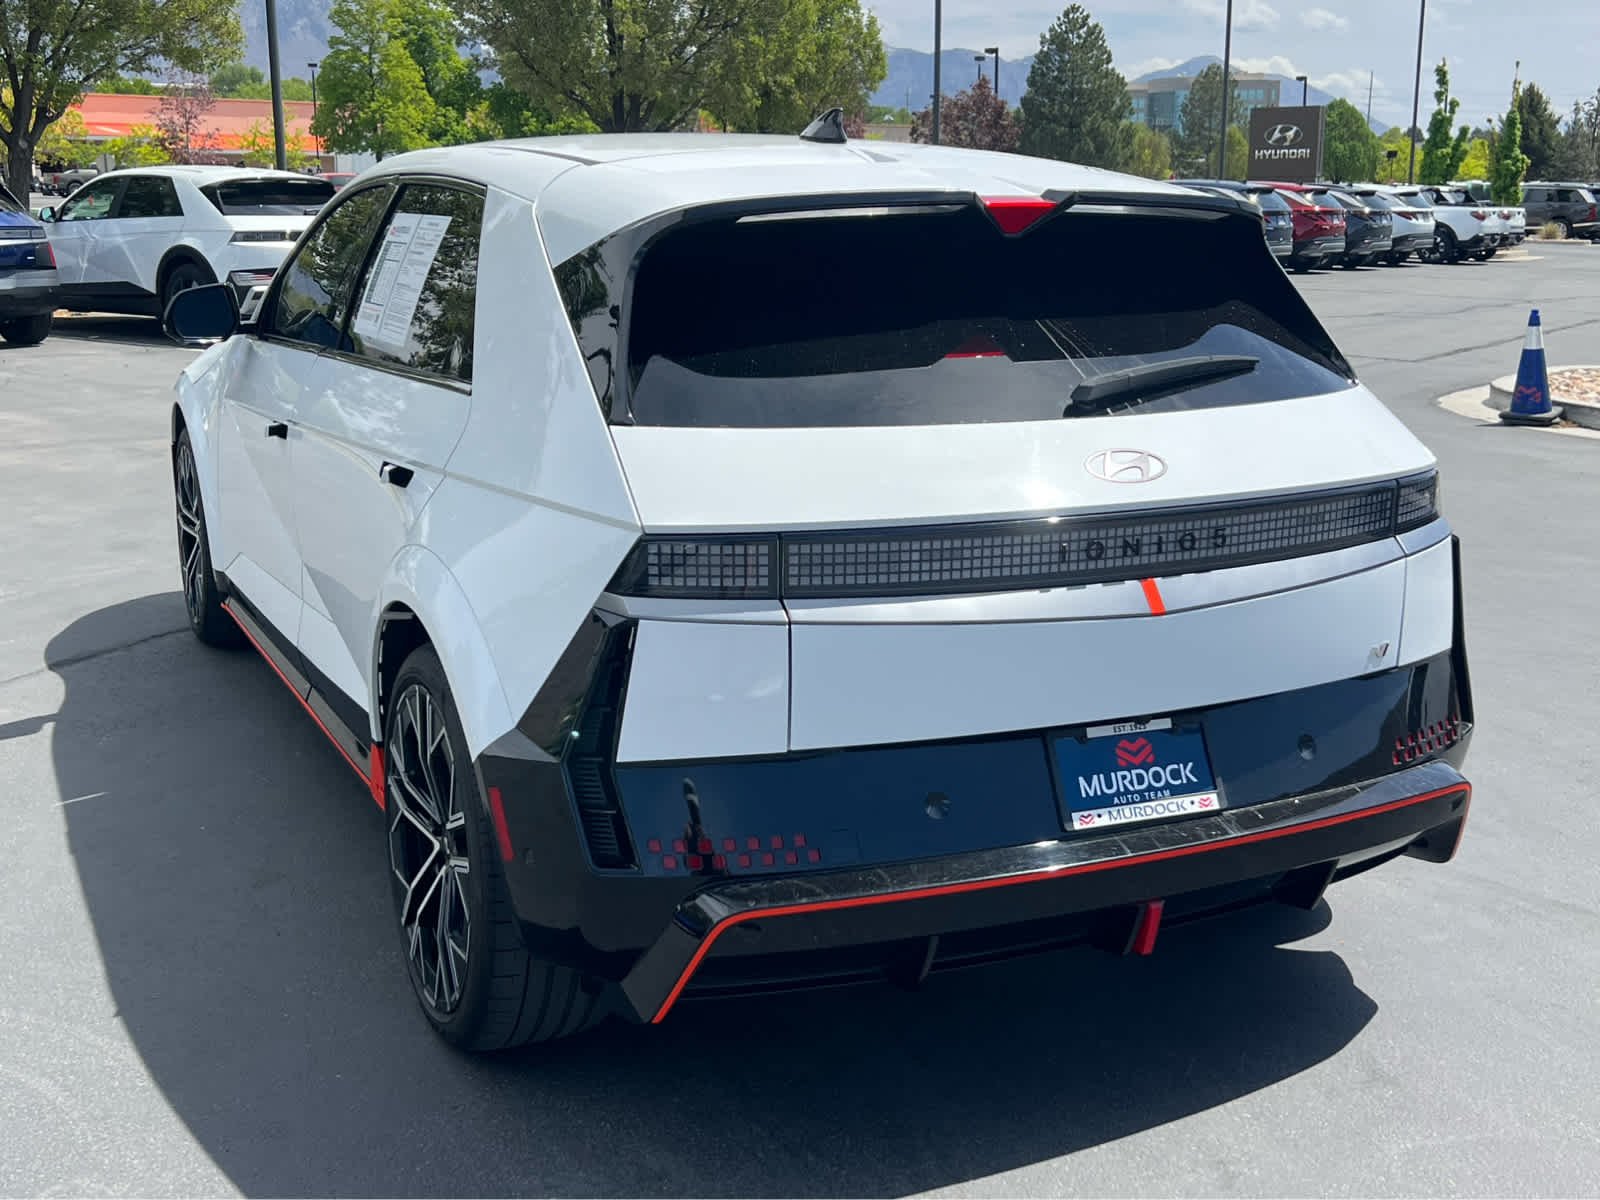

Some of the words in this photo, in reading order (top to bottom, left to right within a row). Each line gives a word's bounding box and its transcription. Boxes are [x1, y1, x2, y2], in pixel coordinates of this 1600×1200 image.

[1254, 148, 1311, 160] HYUNDAI
[1078, 762, 1198, 798] MURDOCK
[1112, 793, 1141, 805] AUTO
[1143, 789, 1171, 801] TEAM
[1107, 800, 1187, 823] MURDOCK
